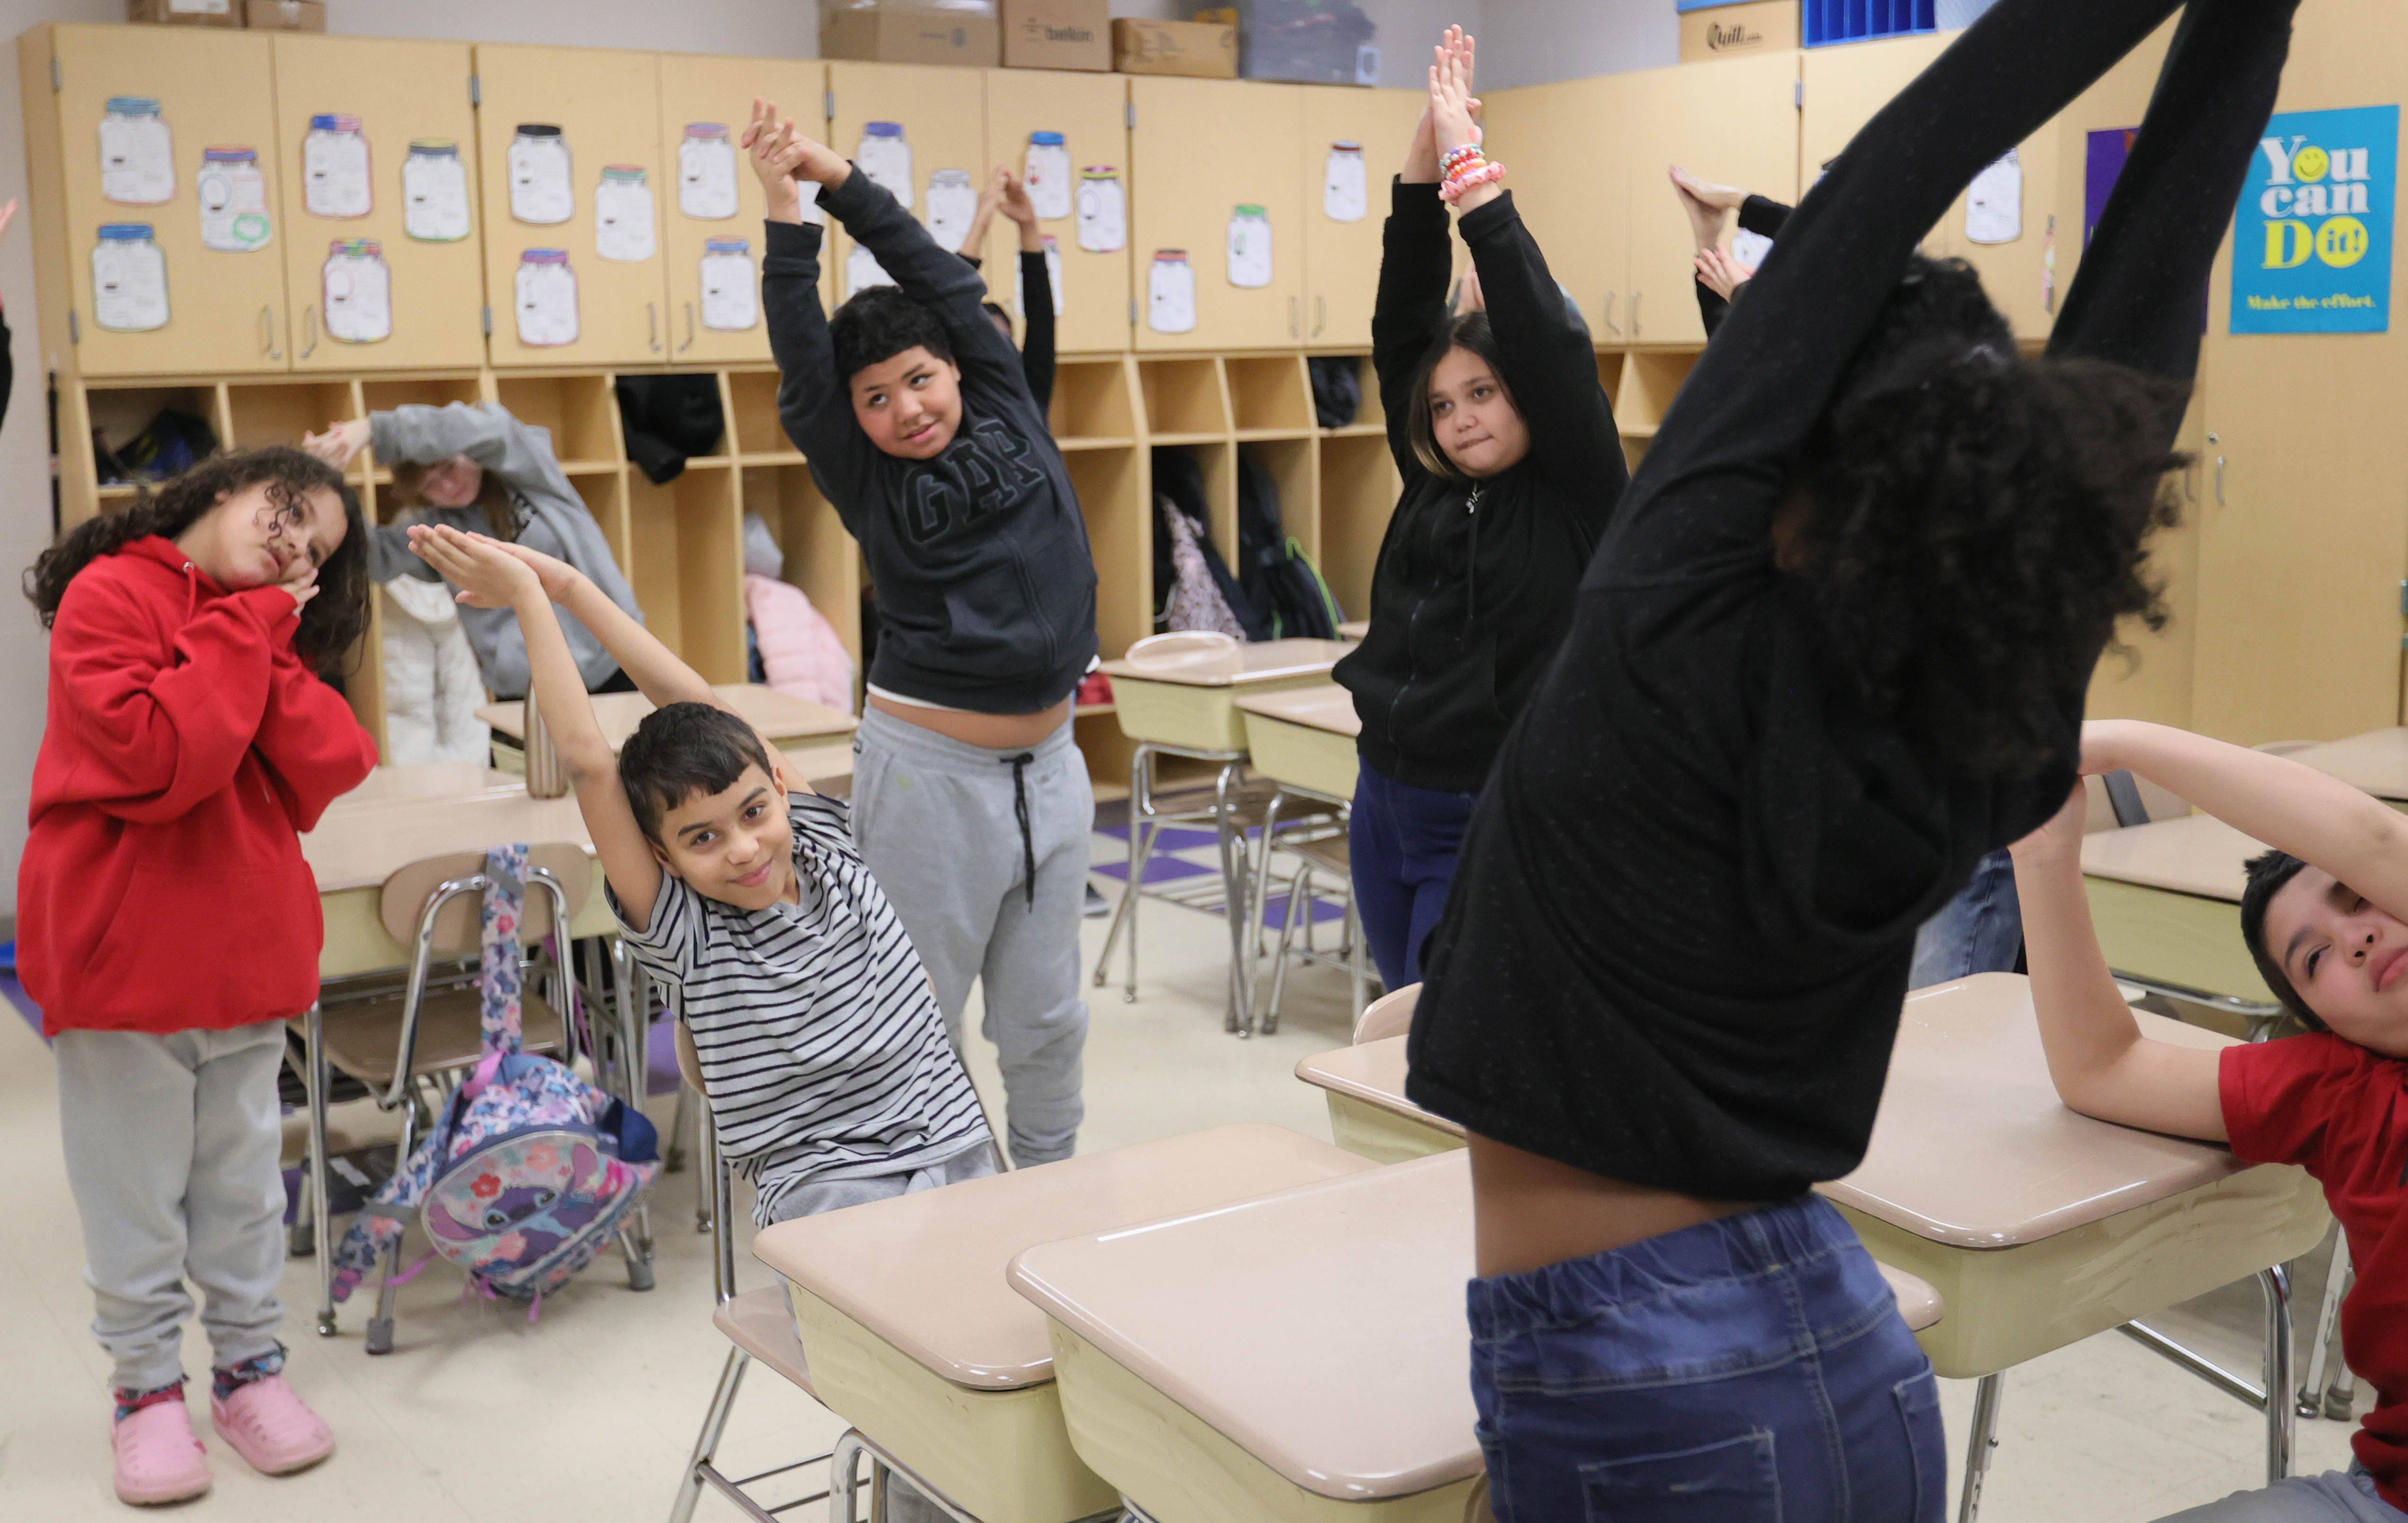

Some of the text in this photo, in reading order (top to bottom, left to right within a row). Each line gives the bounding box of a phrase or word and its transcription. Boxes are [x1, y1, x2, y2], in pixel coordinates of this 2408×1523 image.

[2259, 135, 2371, 185] You
[2260, 182, 2371, 218] can
[2327, 228, 2360, 254] it!
[2247, 293, 2376, 310] Make the effort.
[903, 419, 1045, 545] GAP
